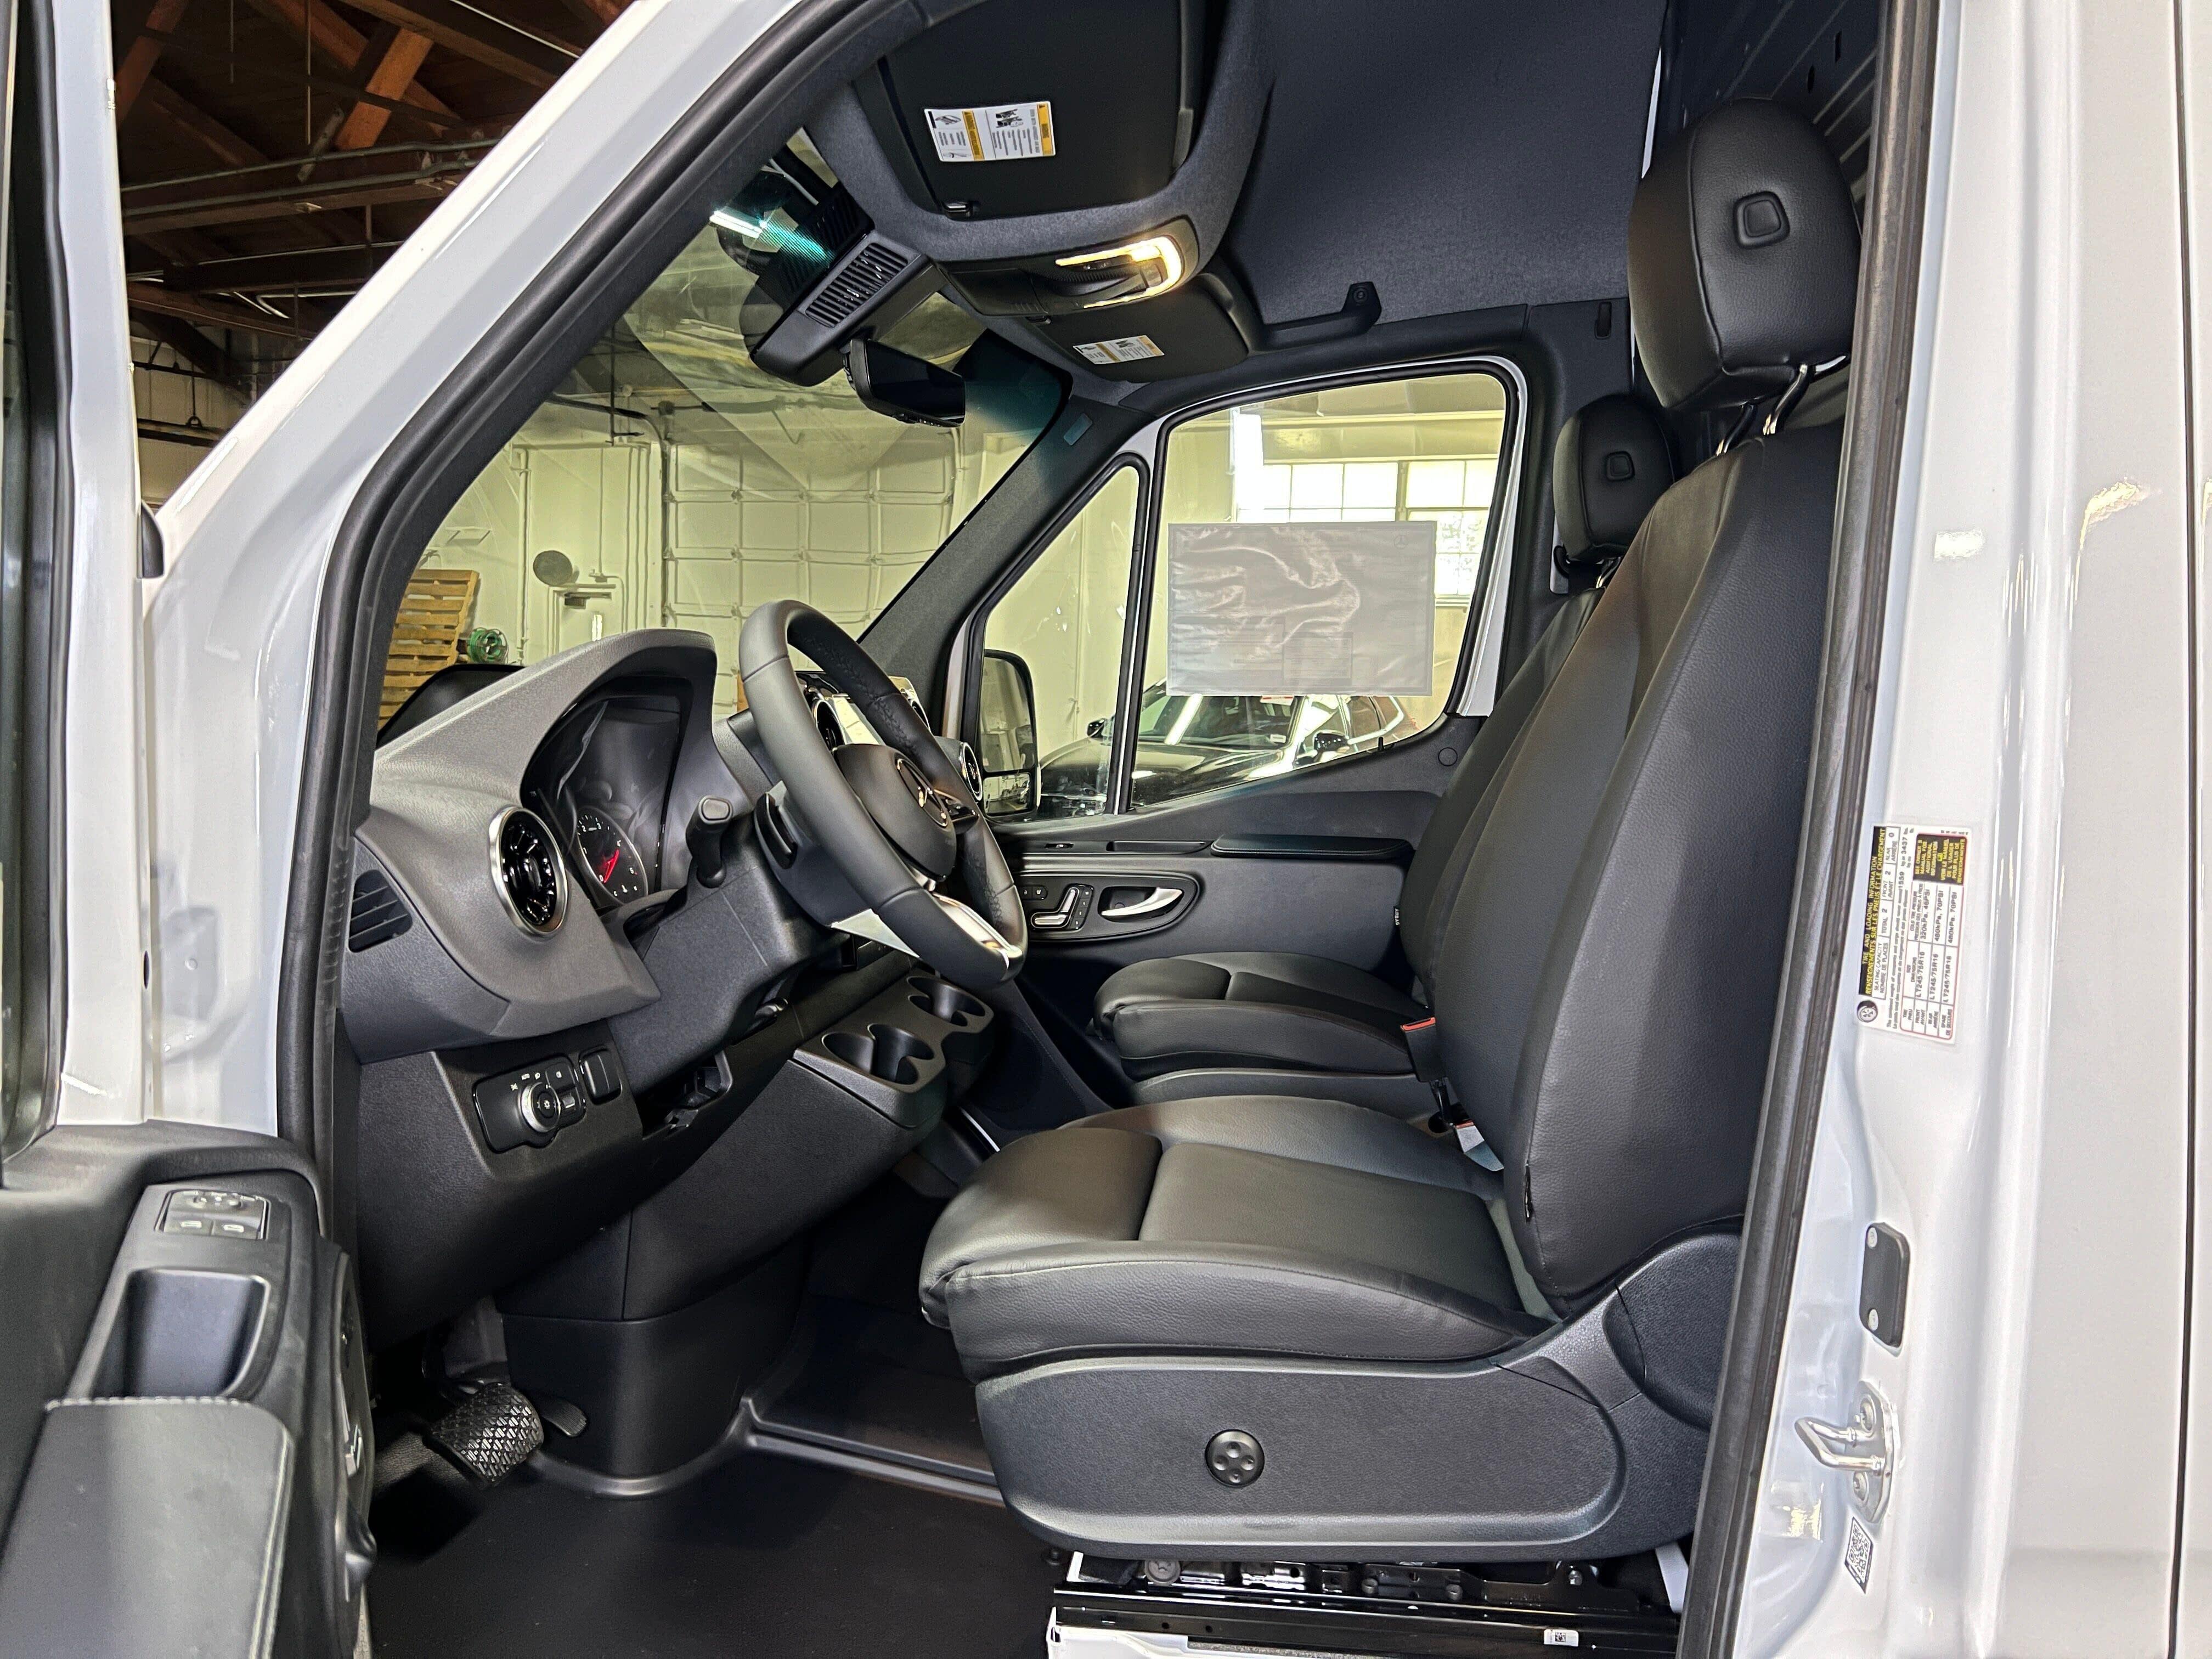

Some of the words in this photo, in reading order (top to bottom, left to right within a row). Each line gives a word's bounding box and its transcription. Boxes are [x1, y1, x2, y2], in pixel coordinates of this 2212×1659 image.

[1866, 939, 1876, 994] RENSEIGNEMENTS
[1877, 828, 1885, 870] CHARGEMENT
[1869, 856, 1877, 898] INFORMATION
